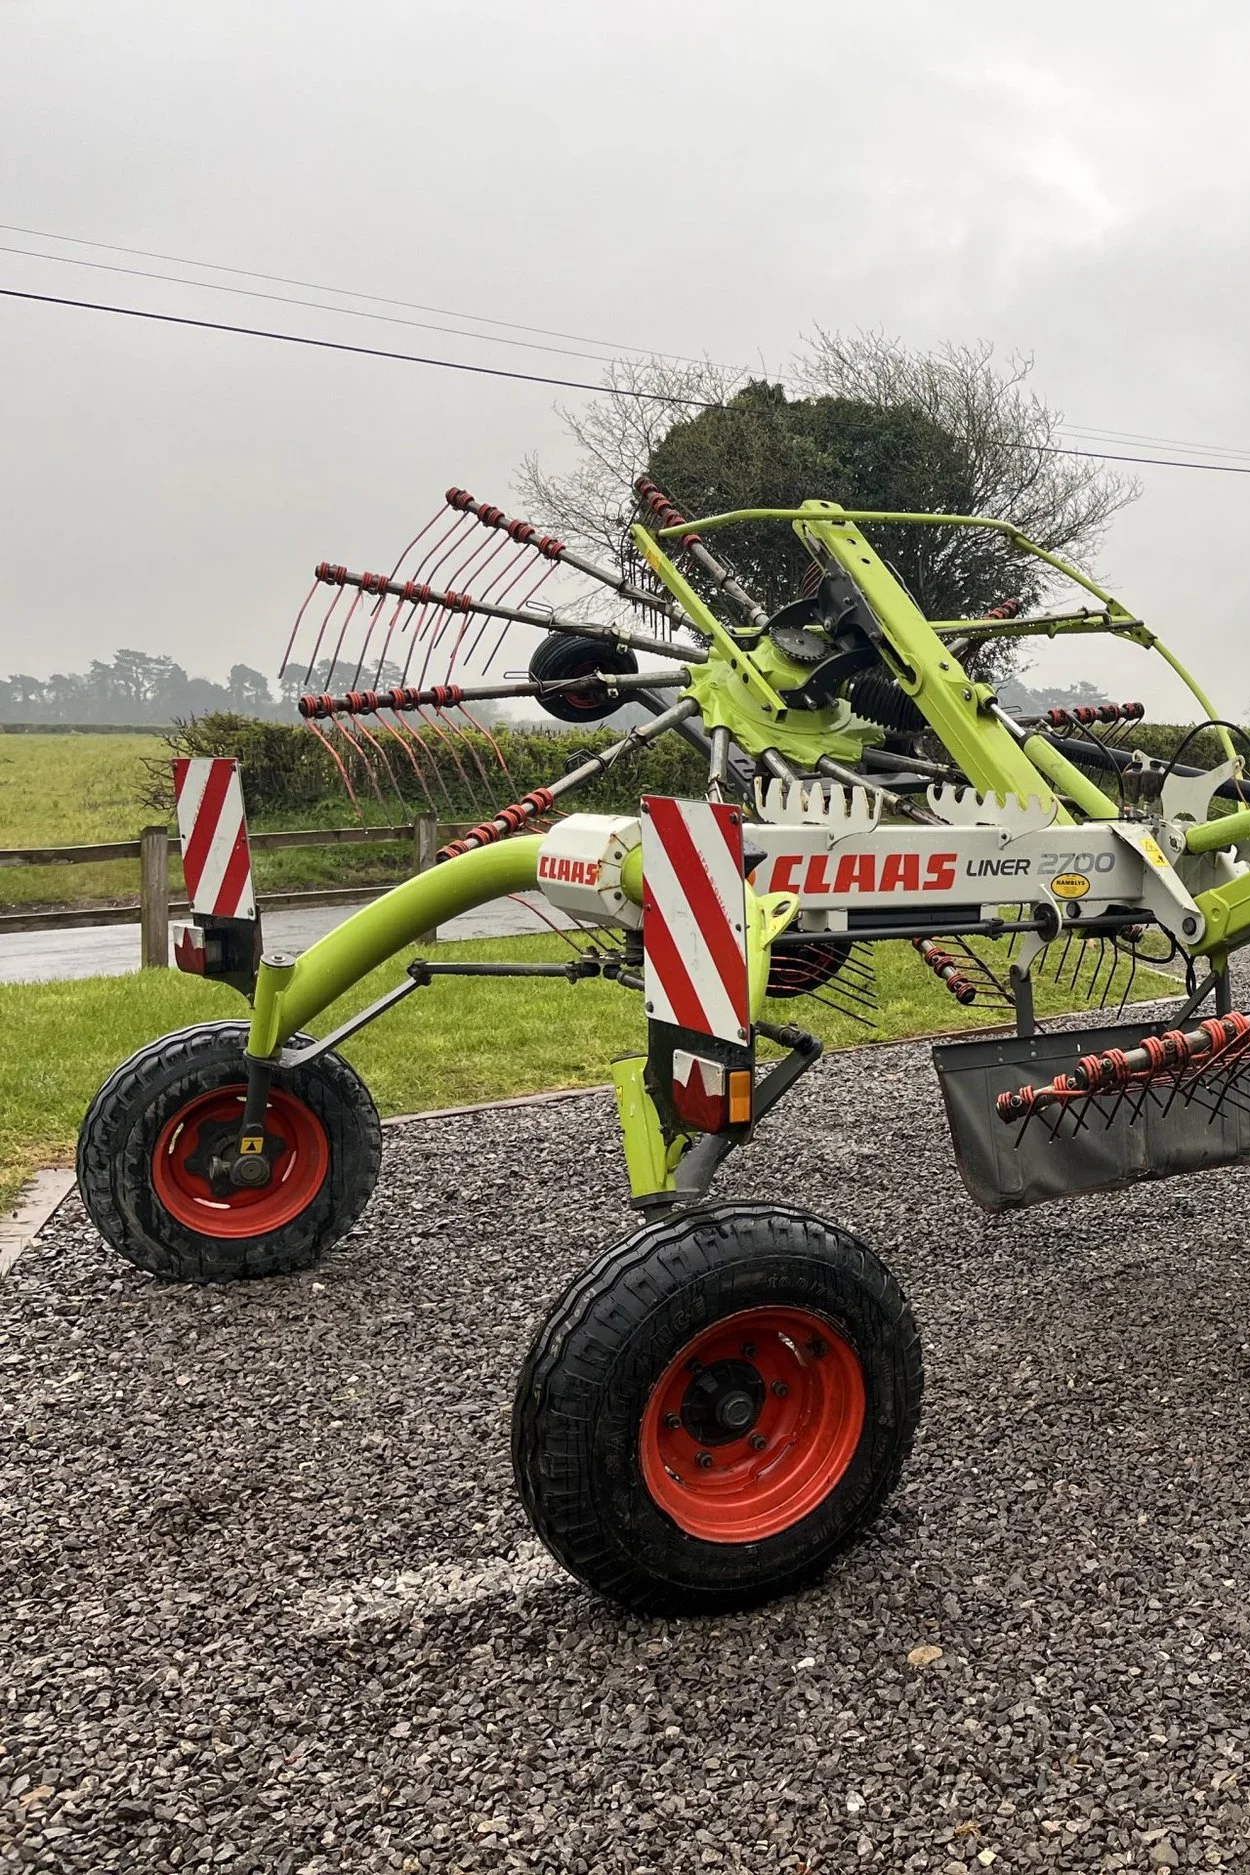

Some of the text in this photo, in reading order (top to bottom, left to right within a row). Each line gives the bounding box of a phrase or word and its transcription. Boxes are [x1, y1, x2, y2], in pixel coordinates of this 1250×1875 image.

[539, 855, 598, 886] CLAAS
[769, 852, 1116, 894] CLAAS LINER 2700
